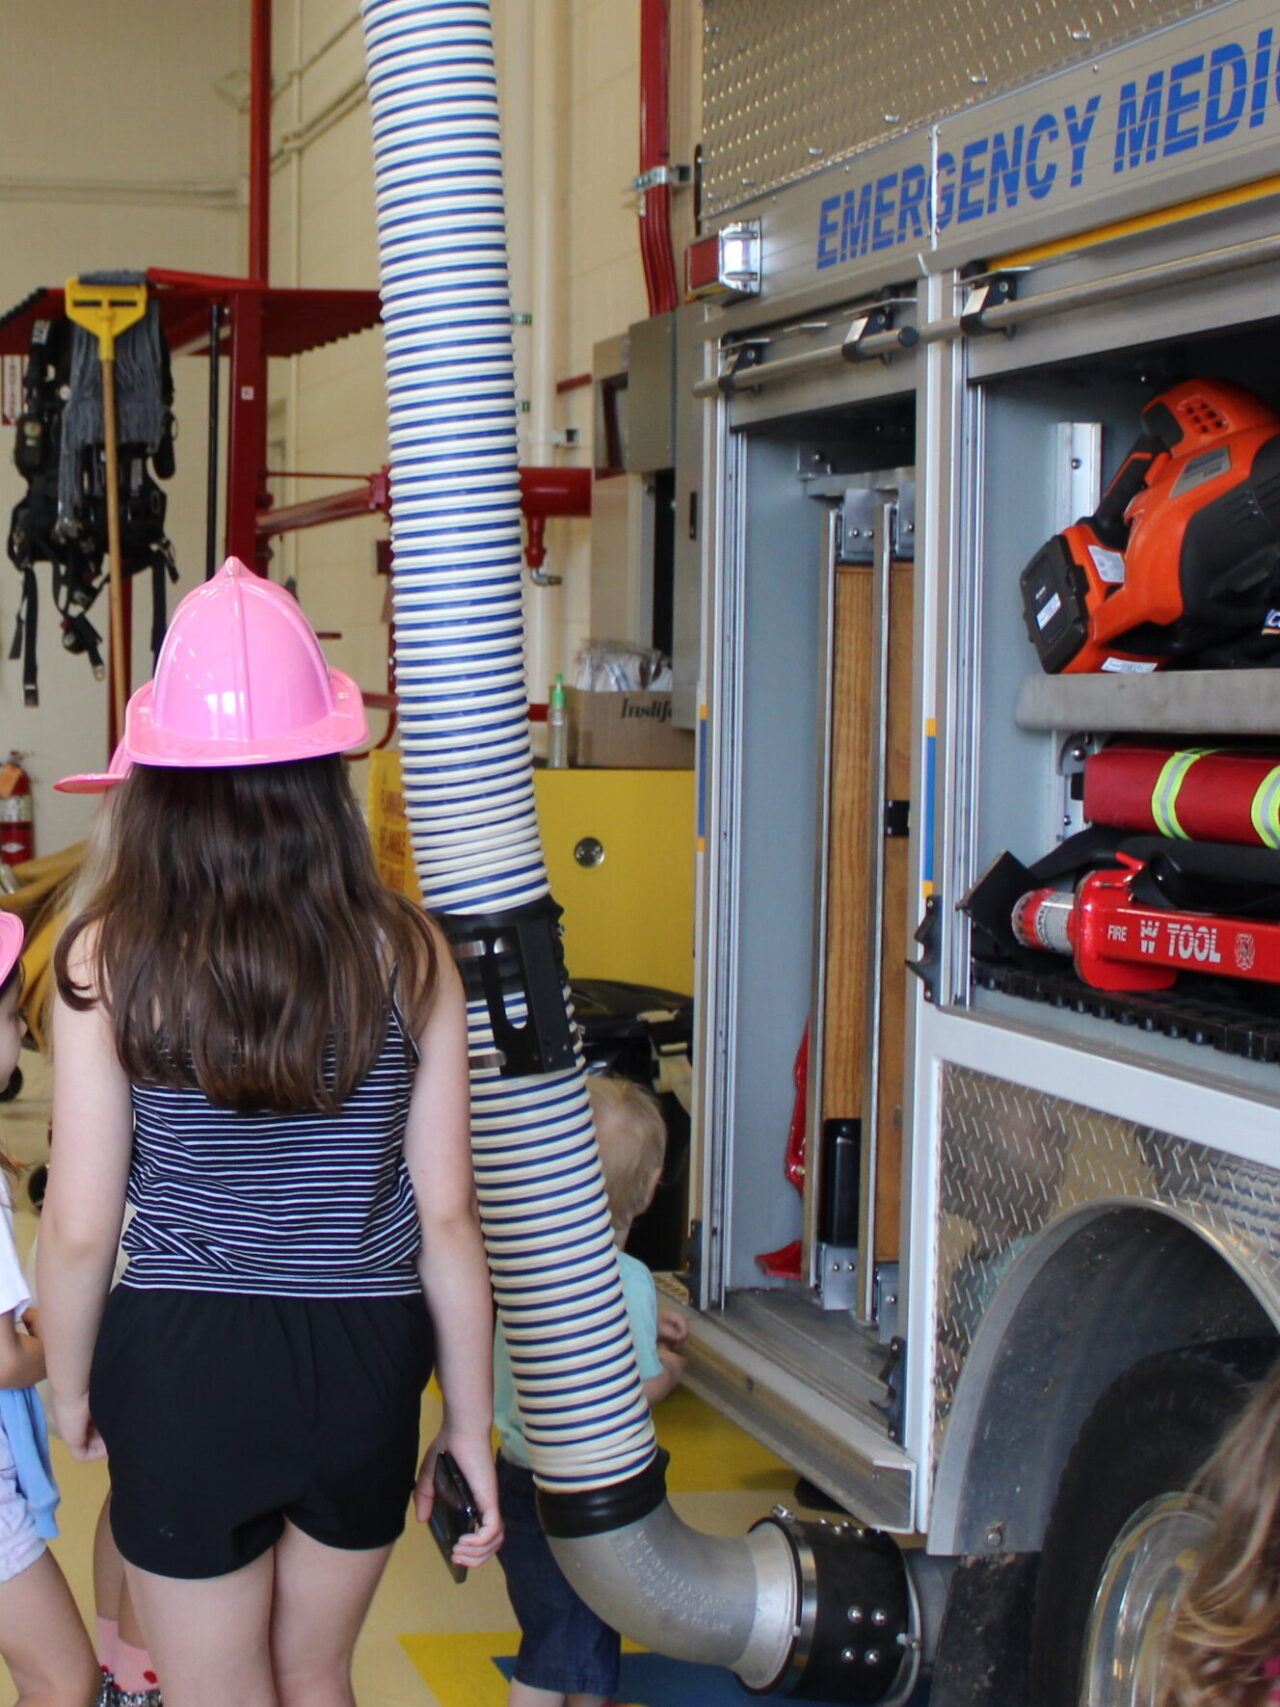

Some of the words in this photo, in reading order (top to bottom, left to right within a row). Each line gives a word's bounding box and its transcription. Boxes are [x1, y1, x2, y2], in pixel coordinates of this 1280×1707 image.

[816, 95, 1101, 270] EMERGENCY
[1113, 27, 1280, 174] MEDI
[1107, 924, 1128, 943] FIRE
[1166, 922, 1222, 965] TOOL
